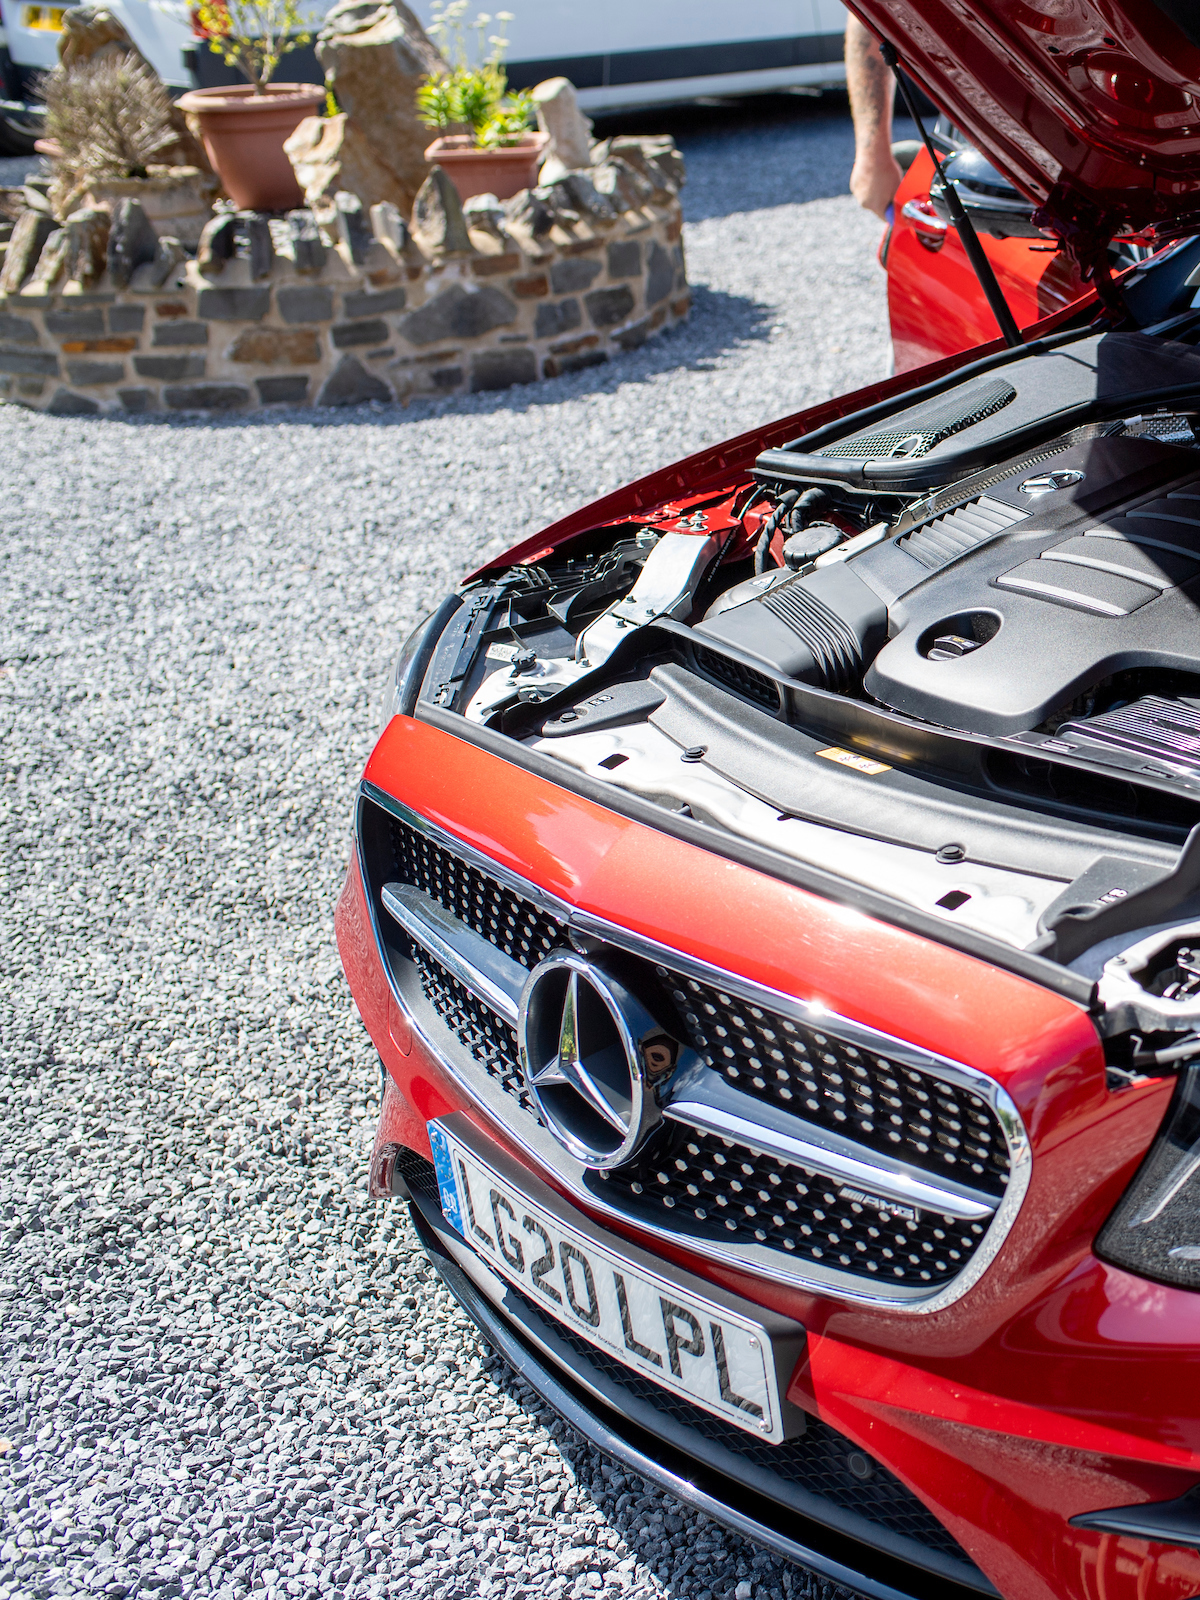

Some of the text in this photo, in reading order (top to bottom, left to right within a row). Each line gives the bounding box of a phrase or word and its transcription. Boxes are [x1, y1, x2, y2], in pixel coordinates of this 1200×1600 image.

[442, 1187, 459, 1213] GB
[863, 1195, 914, 1220] AMG
[458, 1158, 763, 1419] LG20 LPL
